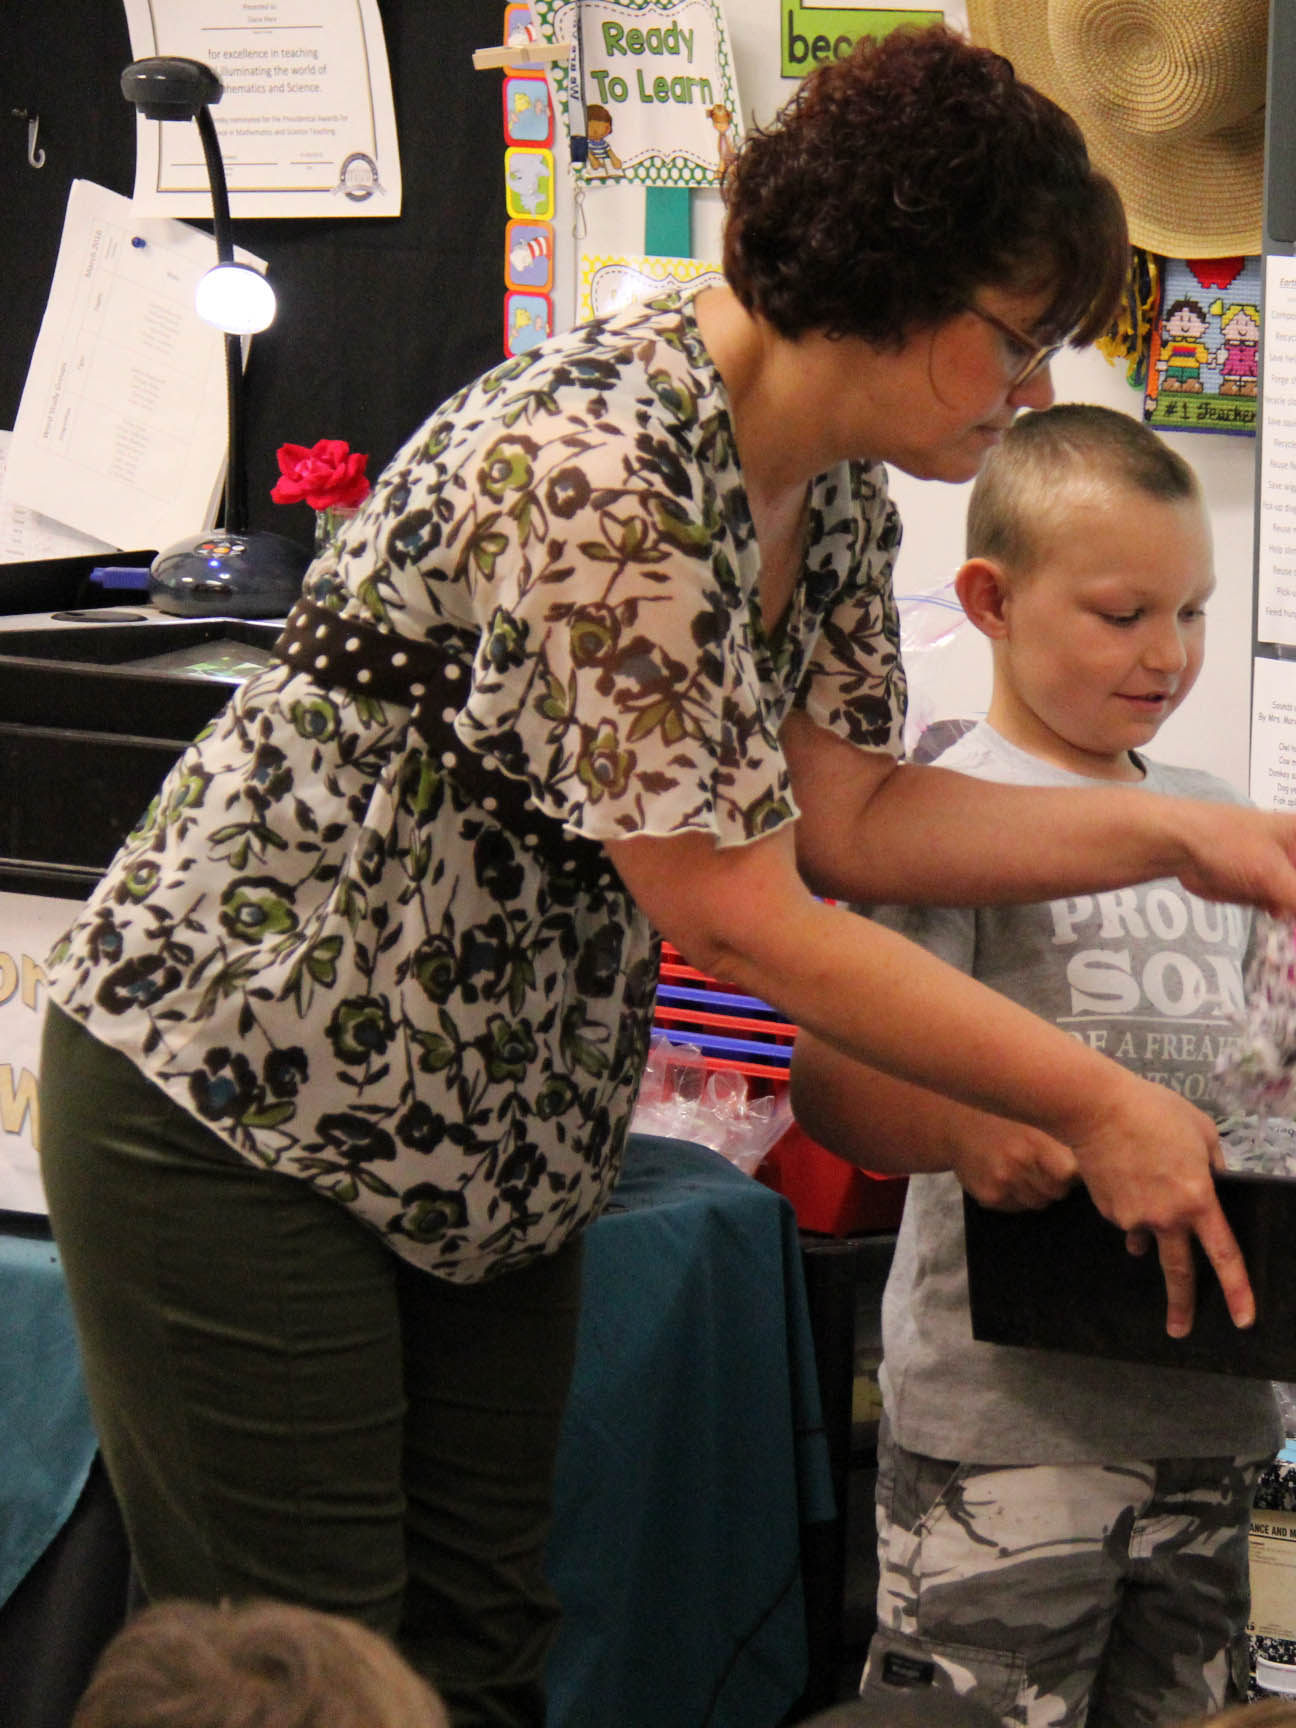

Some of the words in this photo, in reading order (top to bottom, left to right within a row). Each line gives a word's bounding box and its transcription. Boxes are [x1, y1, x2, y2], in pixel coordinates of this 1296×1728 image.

[602, 20, 694, 63] Ready
[208, 48, 221, 59] for
[223, 48, 268, 59] excellence
[270, 48, 279, 58] in
[281, 48, 319, 60] teaching
[273, 65, 288, 76] the
[292, 64, 316, 75] world
[318, 64, 327, 75] of
[268, 82, 284, 94] and
[590, 70, 628, 104] To
[636, 69, 714, 104] Learn
[1197, 403, 1257, 422] Teacher
[1272, 1527, 1288, 1538] AND
